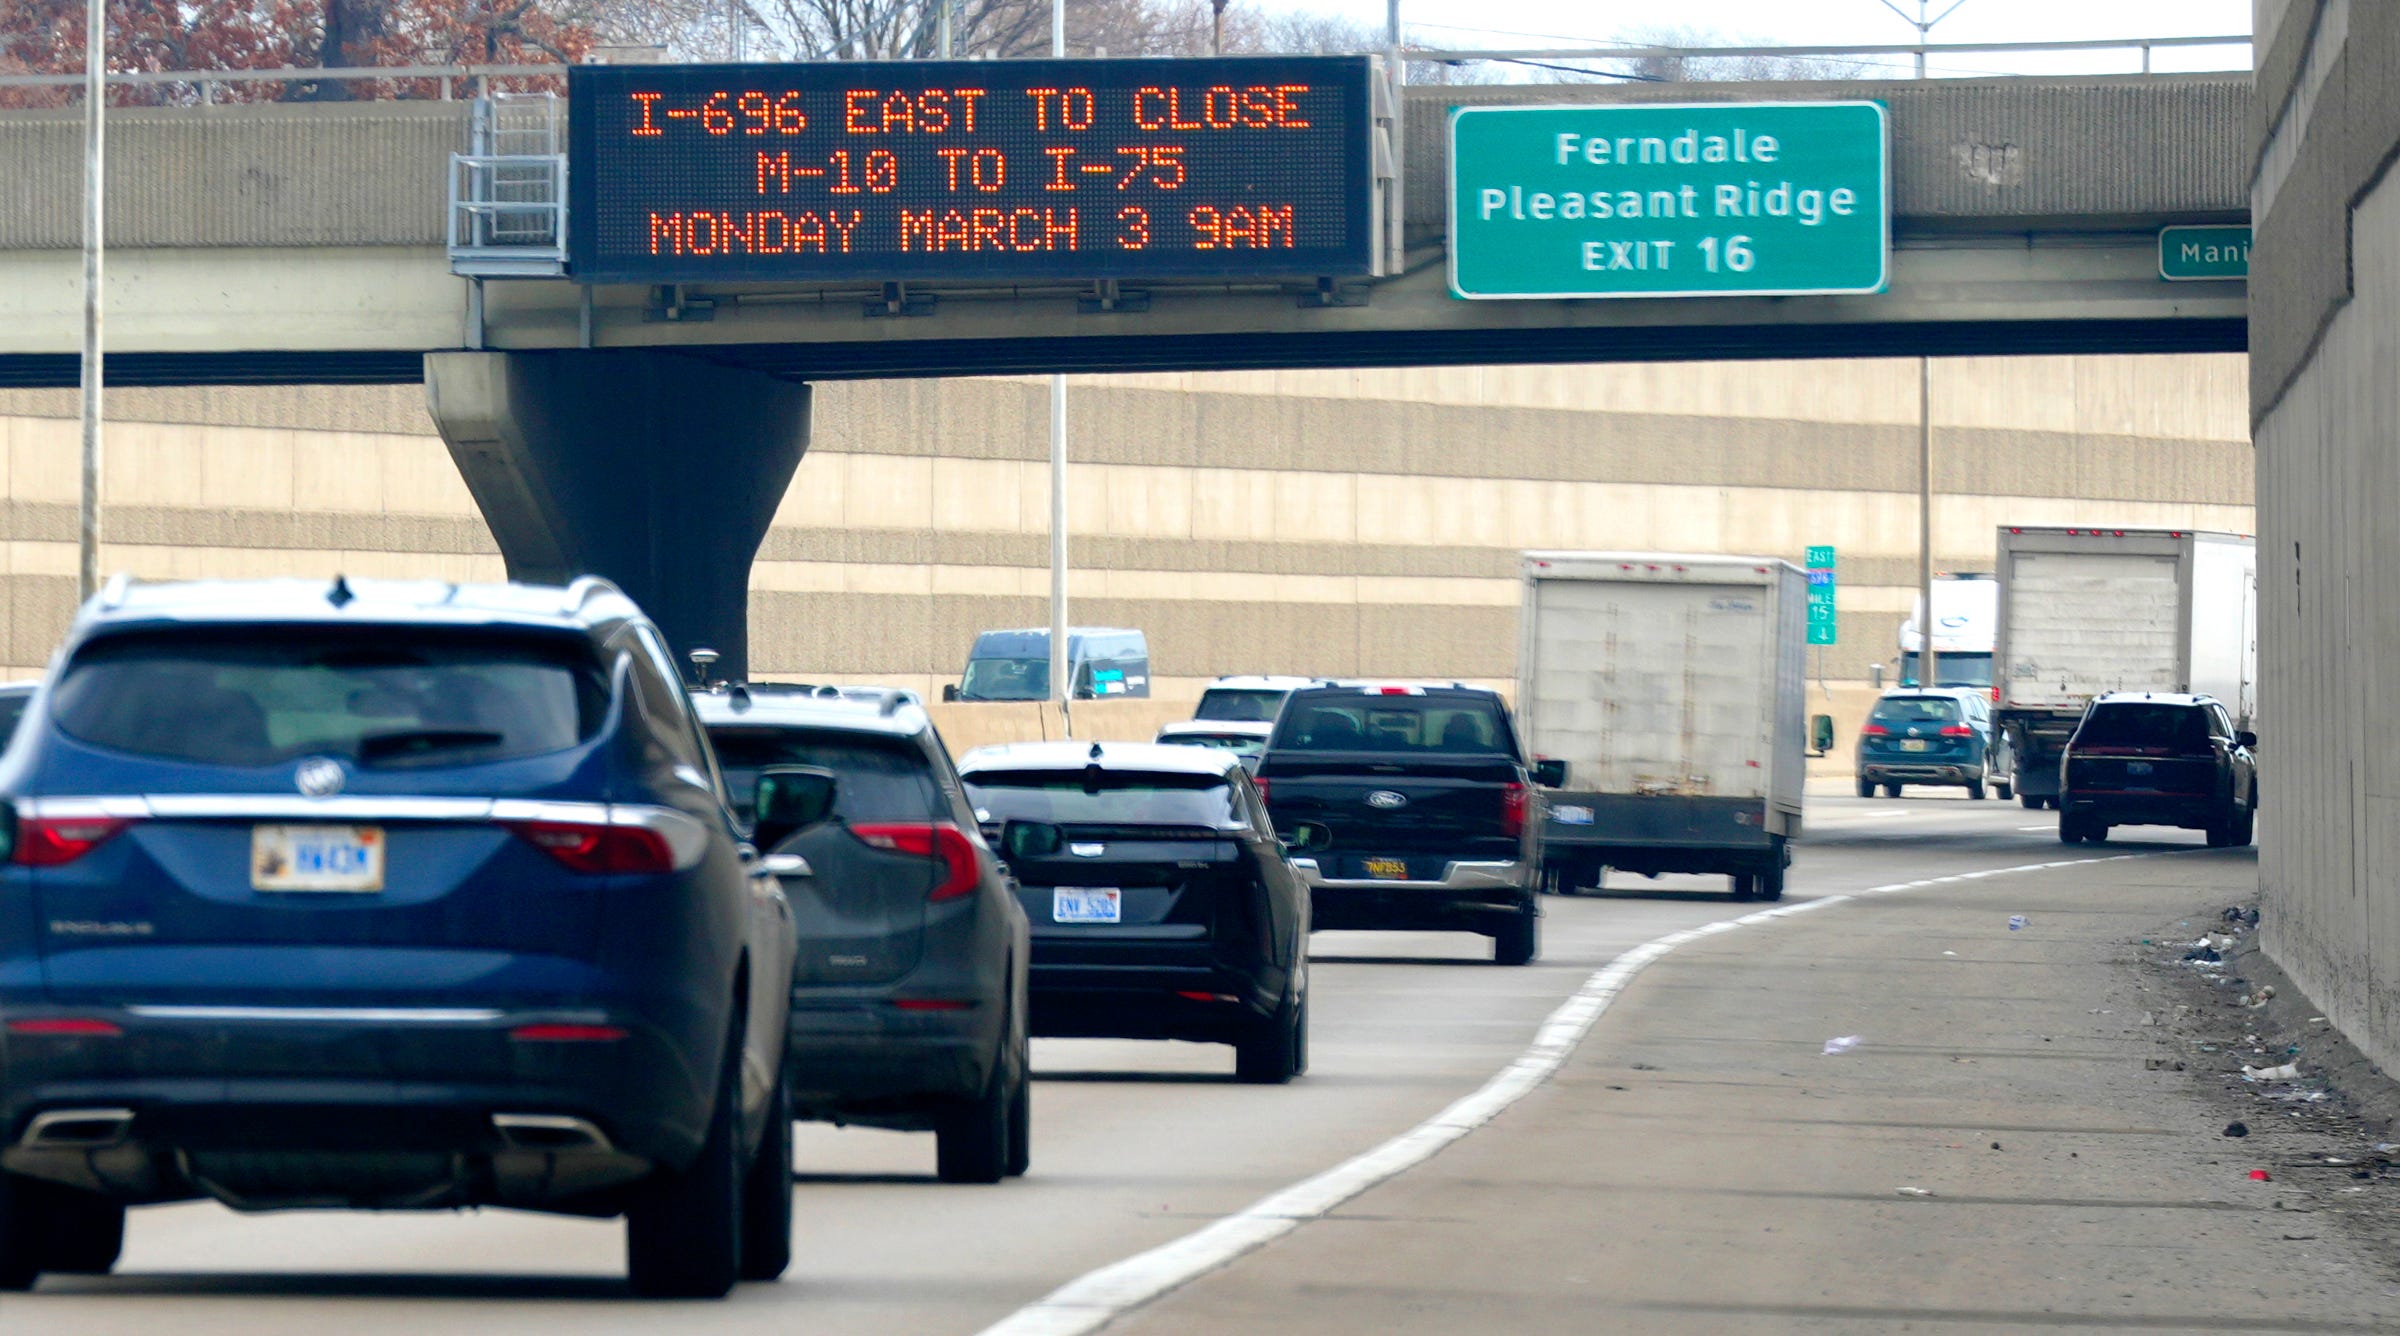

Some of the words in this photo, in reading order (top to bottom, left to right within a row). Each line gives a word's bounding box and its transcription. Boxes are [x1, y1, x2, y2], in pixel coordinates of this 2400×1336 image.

[631, 90, 807, 136] I-696
[845, 88, 986, 134] EAST
[1025, 87, 1094, 131] TO
[1134, 84, 1310, 130] CLOSE
[1557, 128, 1779, 166] Ferndale
[757, 149, 897, 194] M-10
[937, 148, 1006, 193] TO
[1044, 146, 1185, 191] I-75
[1480, 184, 1698, 220] Pleasant
[1715, 181, 1857, 226] Ridge
[650, 209, 861, 255] MONDAY
[901, 207, 1078, 252] MARCH
[1117, 206, 1150, 250] 3
[1189, 204, 1293, 249] 9AM
[1582, 241, 1675, 271] EXIT
[1699, 235, 1755, 273] 16
[2181, 241, 2248, 263] Mani
[1807, 550, 1831, 563] EAST
[1808, 593, 1832, 605] MILE
[1812, 605, 1828, 620] 15
